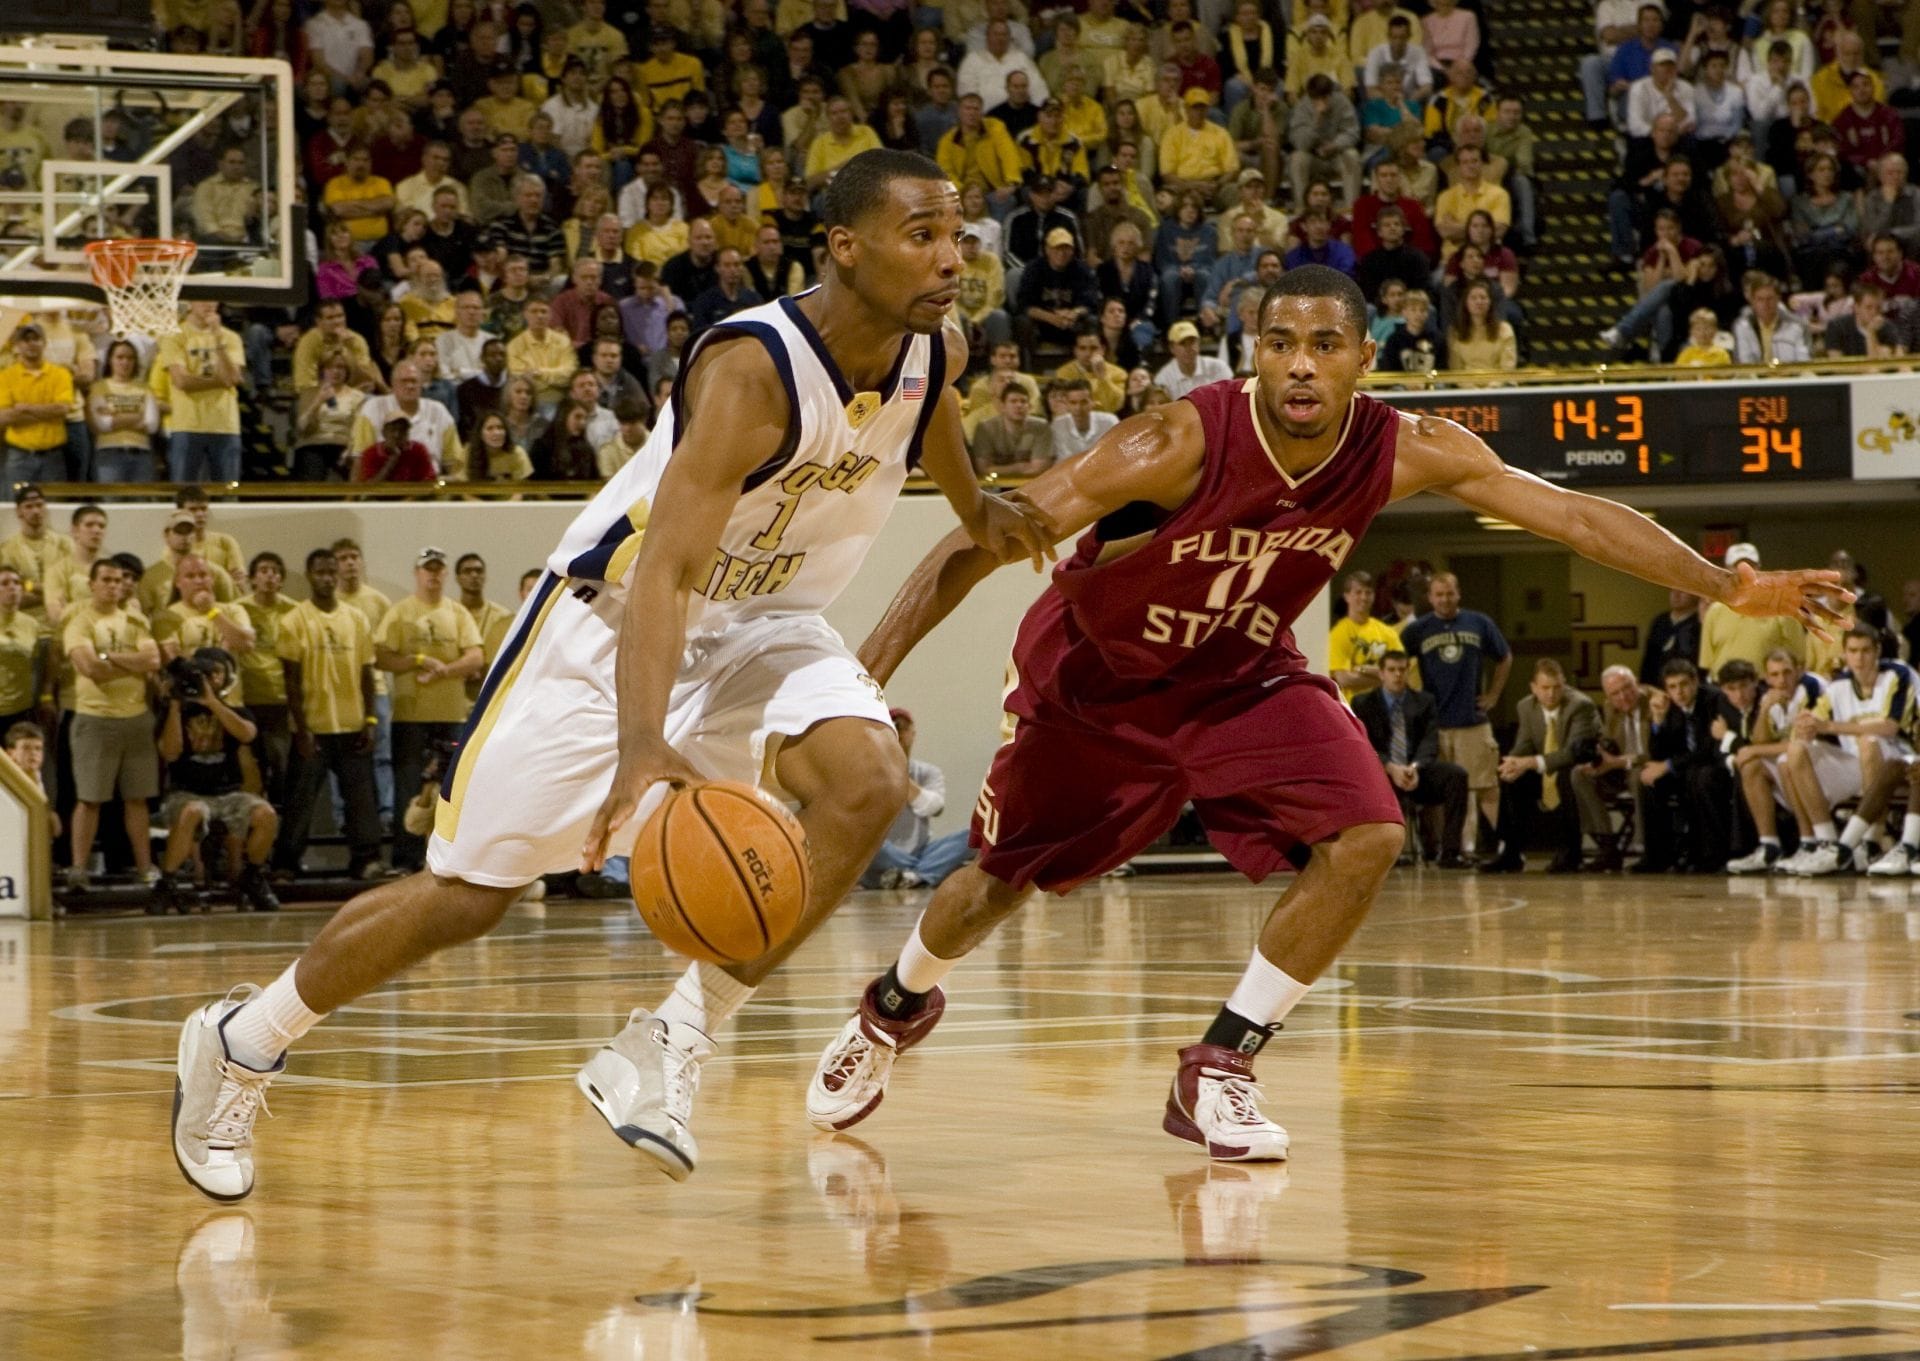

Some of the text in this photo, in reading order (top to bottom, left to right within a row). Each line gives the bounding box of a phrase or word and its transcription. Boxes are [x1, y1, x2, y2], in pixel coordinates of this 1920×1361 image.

[1553, 395, 1644, 440] 14.3
[1739, 396, 1788, 424] FSU
[1565, 444, 1649, 473] PERIOD 1
[1741, 427, 1802, 472] 34
[750, 492, 802, 551] 1
[1276, 499, 1297, 509] FSU
[1168, 526, 1355, 572] FLORIDA
[693, 547, 807, 602] TECH
[1205, 550, 1281, 610] 11
[741, 847, 775, 898] ROCK
